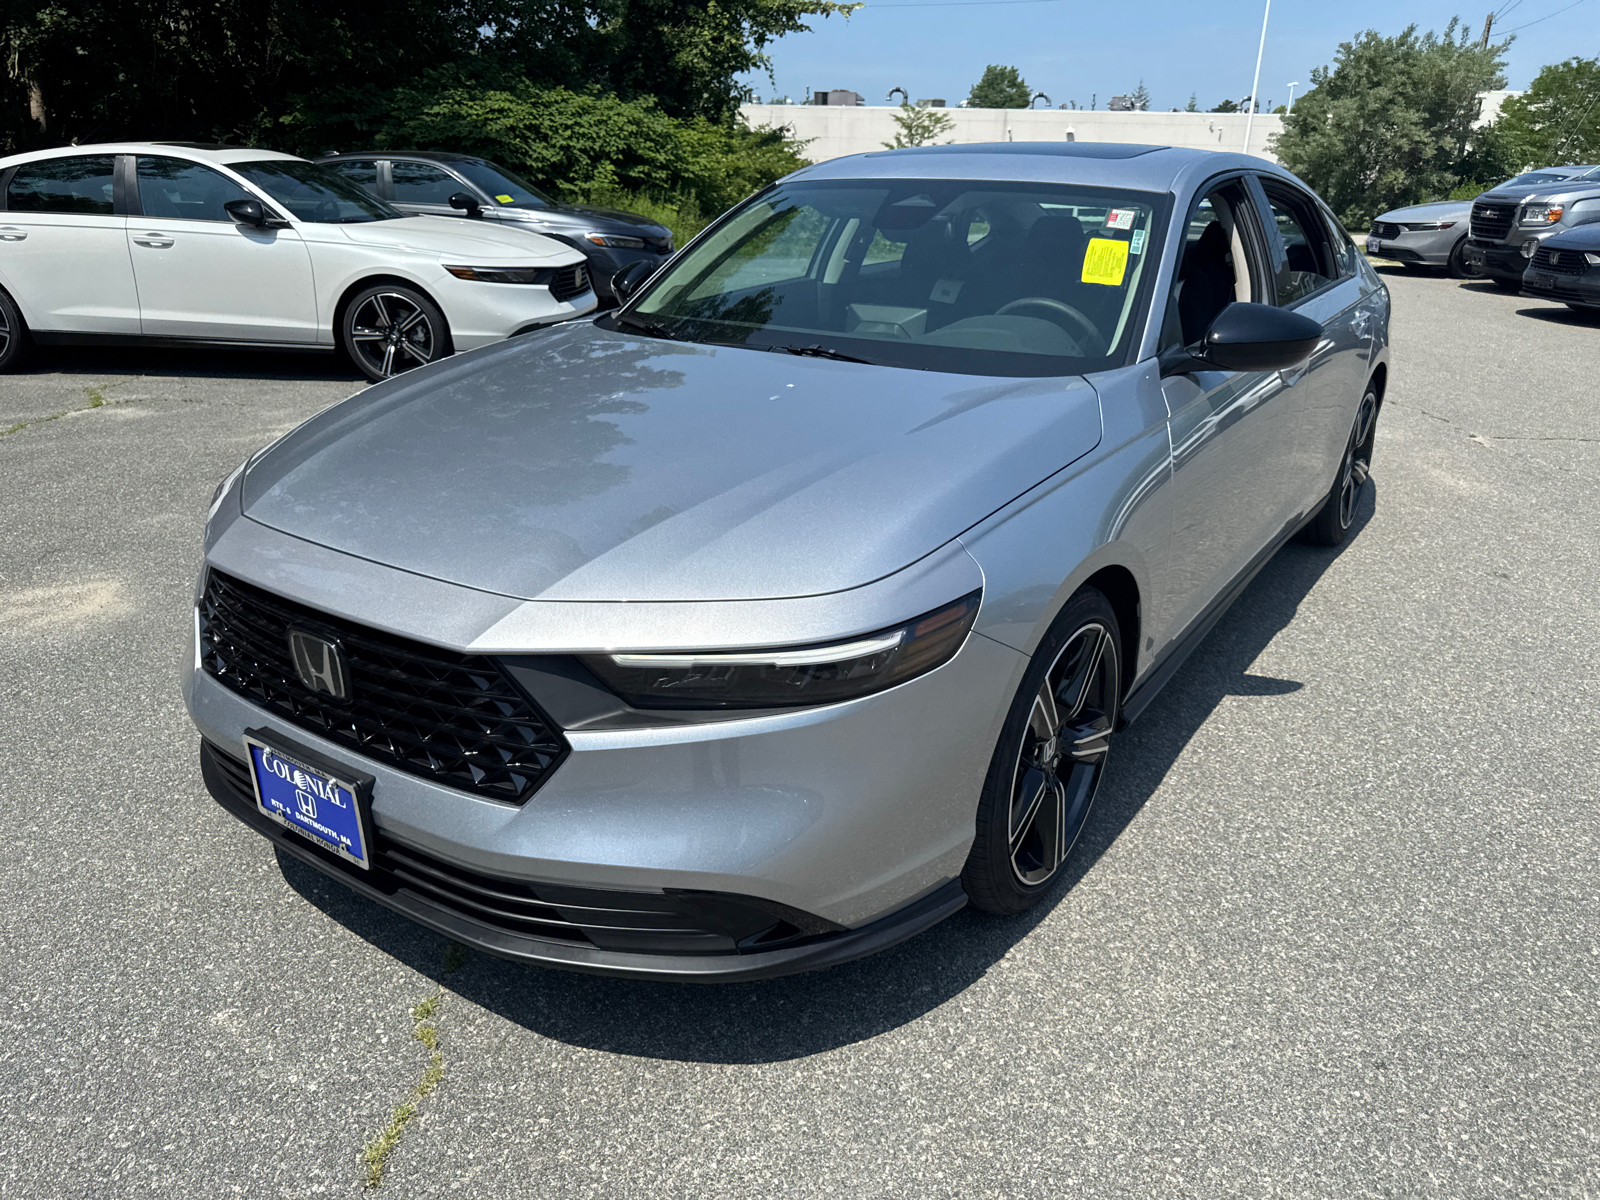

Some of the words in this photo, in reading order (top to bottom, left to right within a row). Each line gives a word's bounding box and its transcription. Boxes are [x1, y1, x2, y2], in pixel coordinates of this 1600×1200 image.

[262, 751, 346, 809] COLONIAL
[295, 811, 340, 841] DARTMOUTH,
[340, 835, 352, 846] MA
